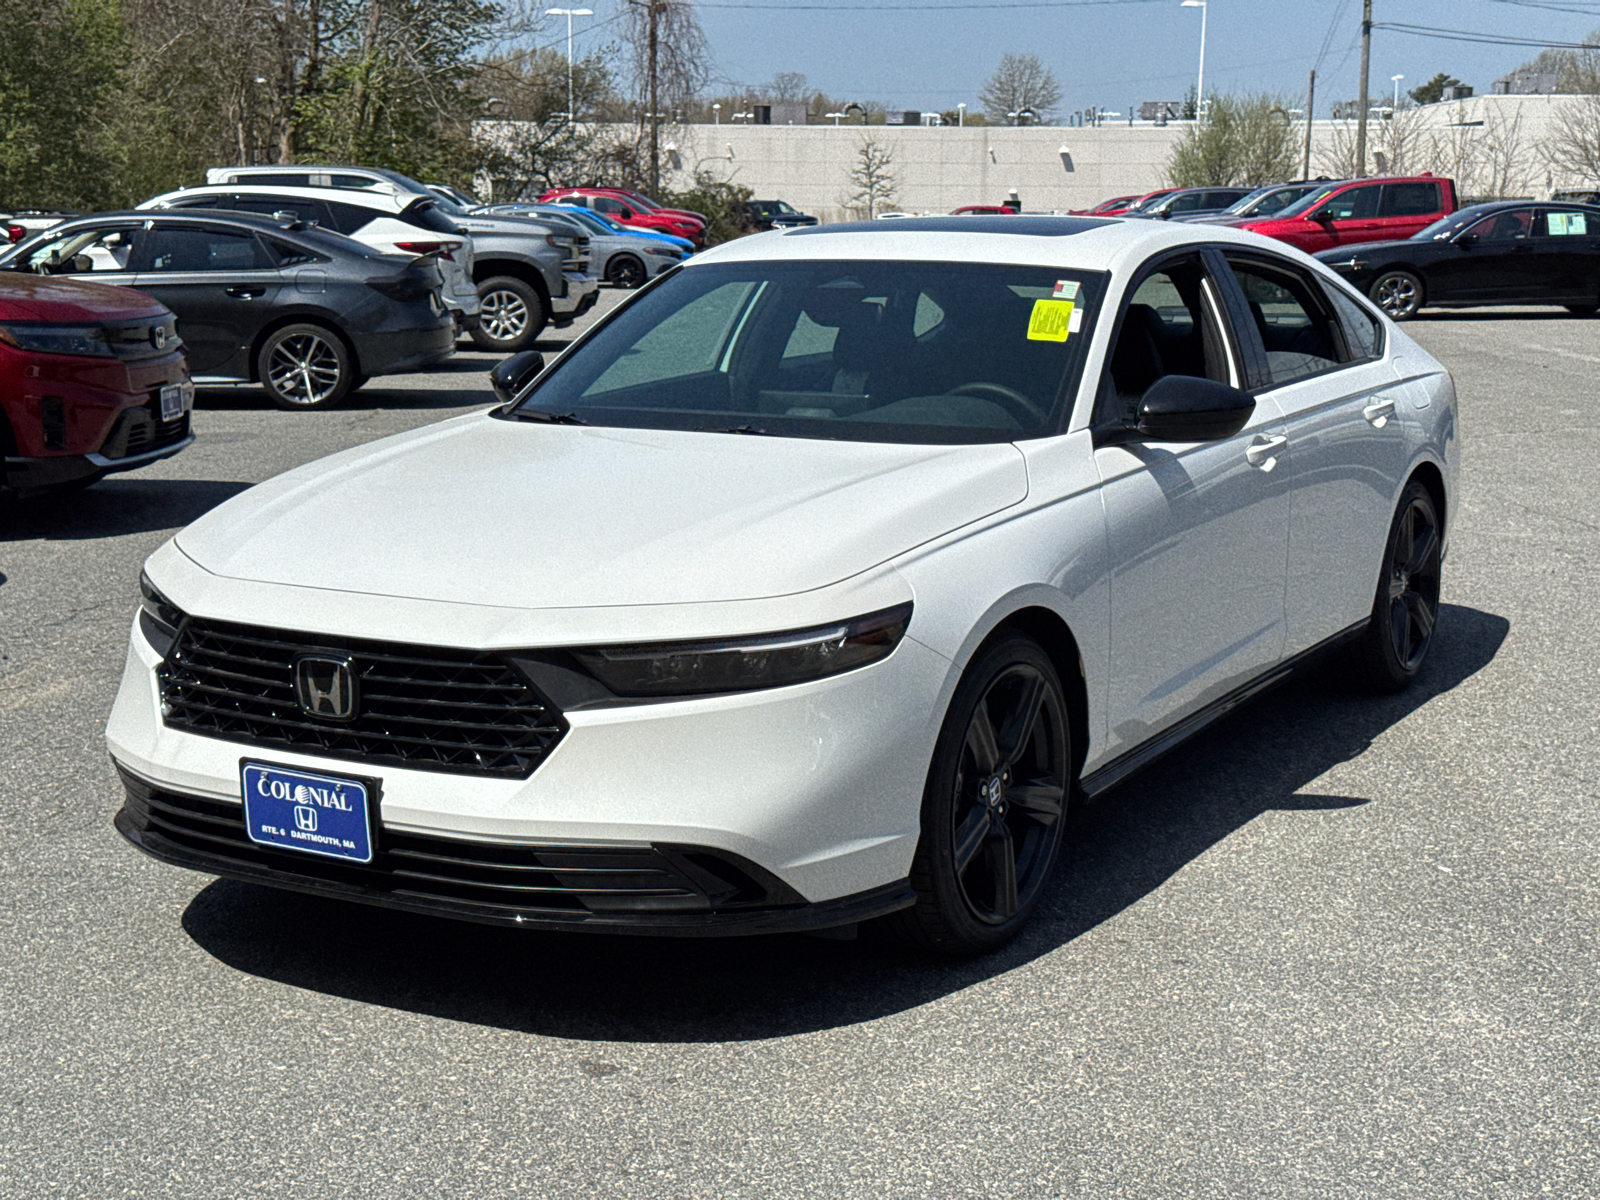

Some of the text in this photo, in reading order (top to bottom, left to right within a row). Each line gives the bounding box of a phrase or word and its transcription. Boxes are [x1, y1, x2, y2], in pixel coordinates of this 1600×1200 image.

[257, 778, 353, 812] COLONIAL
[261, 825, 279, 835] RTE.
[290, 830, 341, 848] DARTMOUTH,
[342, 840, 356, 849] MA
